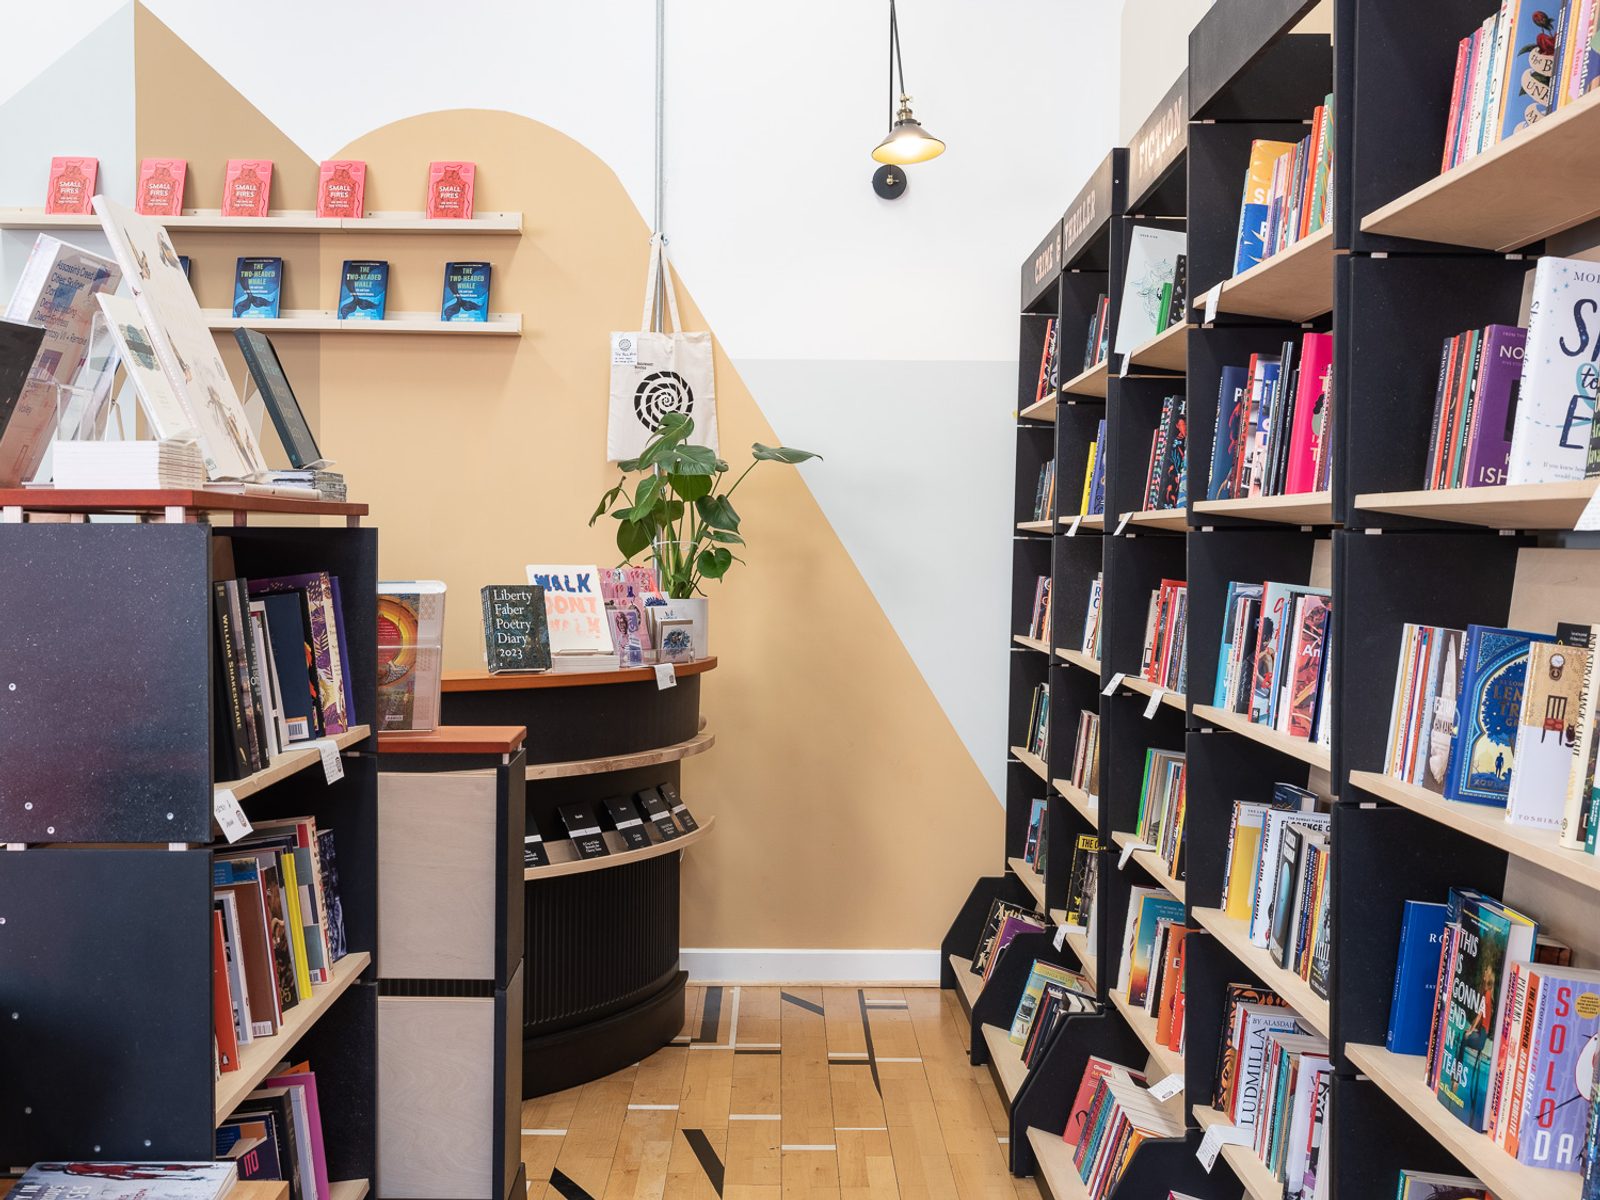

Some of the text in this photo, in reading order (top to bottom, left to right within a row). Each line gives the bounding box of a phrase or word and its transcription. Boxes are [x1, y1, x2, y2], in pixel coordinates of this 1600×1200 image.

[1138, 95, 1182, 179] FICTION
[149, 189, 169, 197] FIRES
[234, 183, 257, 191] SMALL
[235, 190, 255, 198] FIRES
[1065, 189, 1095, 252] THRILLER
[1034, 234, 1061, 285] CRIME &
[240, 270, 276, 278] TWO-HEADED
[346, 273, 382, 281] TWO-HEADED
[534, 573, 592, 593] WALK
[493, 588, 532, 605] Liberty
[494, 603, 525, 615] Faber
[496, 618, 531, 634] Poetry
[497, 632, 528, 648] Diary
[499, 648, 523, 659] 2023
[1584, 633, 1597, 679] INDUSTRY
[222, 613, 242, 730] WILLIAM SHAKESPEARE
[1577, 691, 1589, 721] MAGIC
[1572, 733, 1583, 757] LIGHT
[1517, 813, 1559, 825] TOSHIKA
[1081, 838, 1094, 848] THE
[1458, 927, 1479, 958] THIS
[1454, 953, 1464, 974] IS
[1451, 977, 1487, 1019] GONNA
[1512, 976, 1527, 1024] PILGRIMS
[1528, 986, 1537, 1003] THE
[1252, 1017, 1295, 1029] BY ALASDAI
[1447, 1001, 1467, 1031] END
[1521, 1002, 1535, 1049] LATECOMER
[1445, 1028, 1455, 1050] IN
[1530, 1038, 1541, 1073] SOLO
[1240, 1027, 1267, 1127] LUDMILLA
[1440, 1052, 1469, 1088] TEARS
